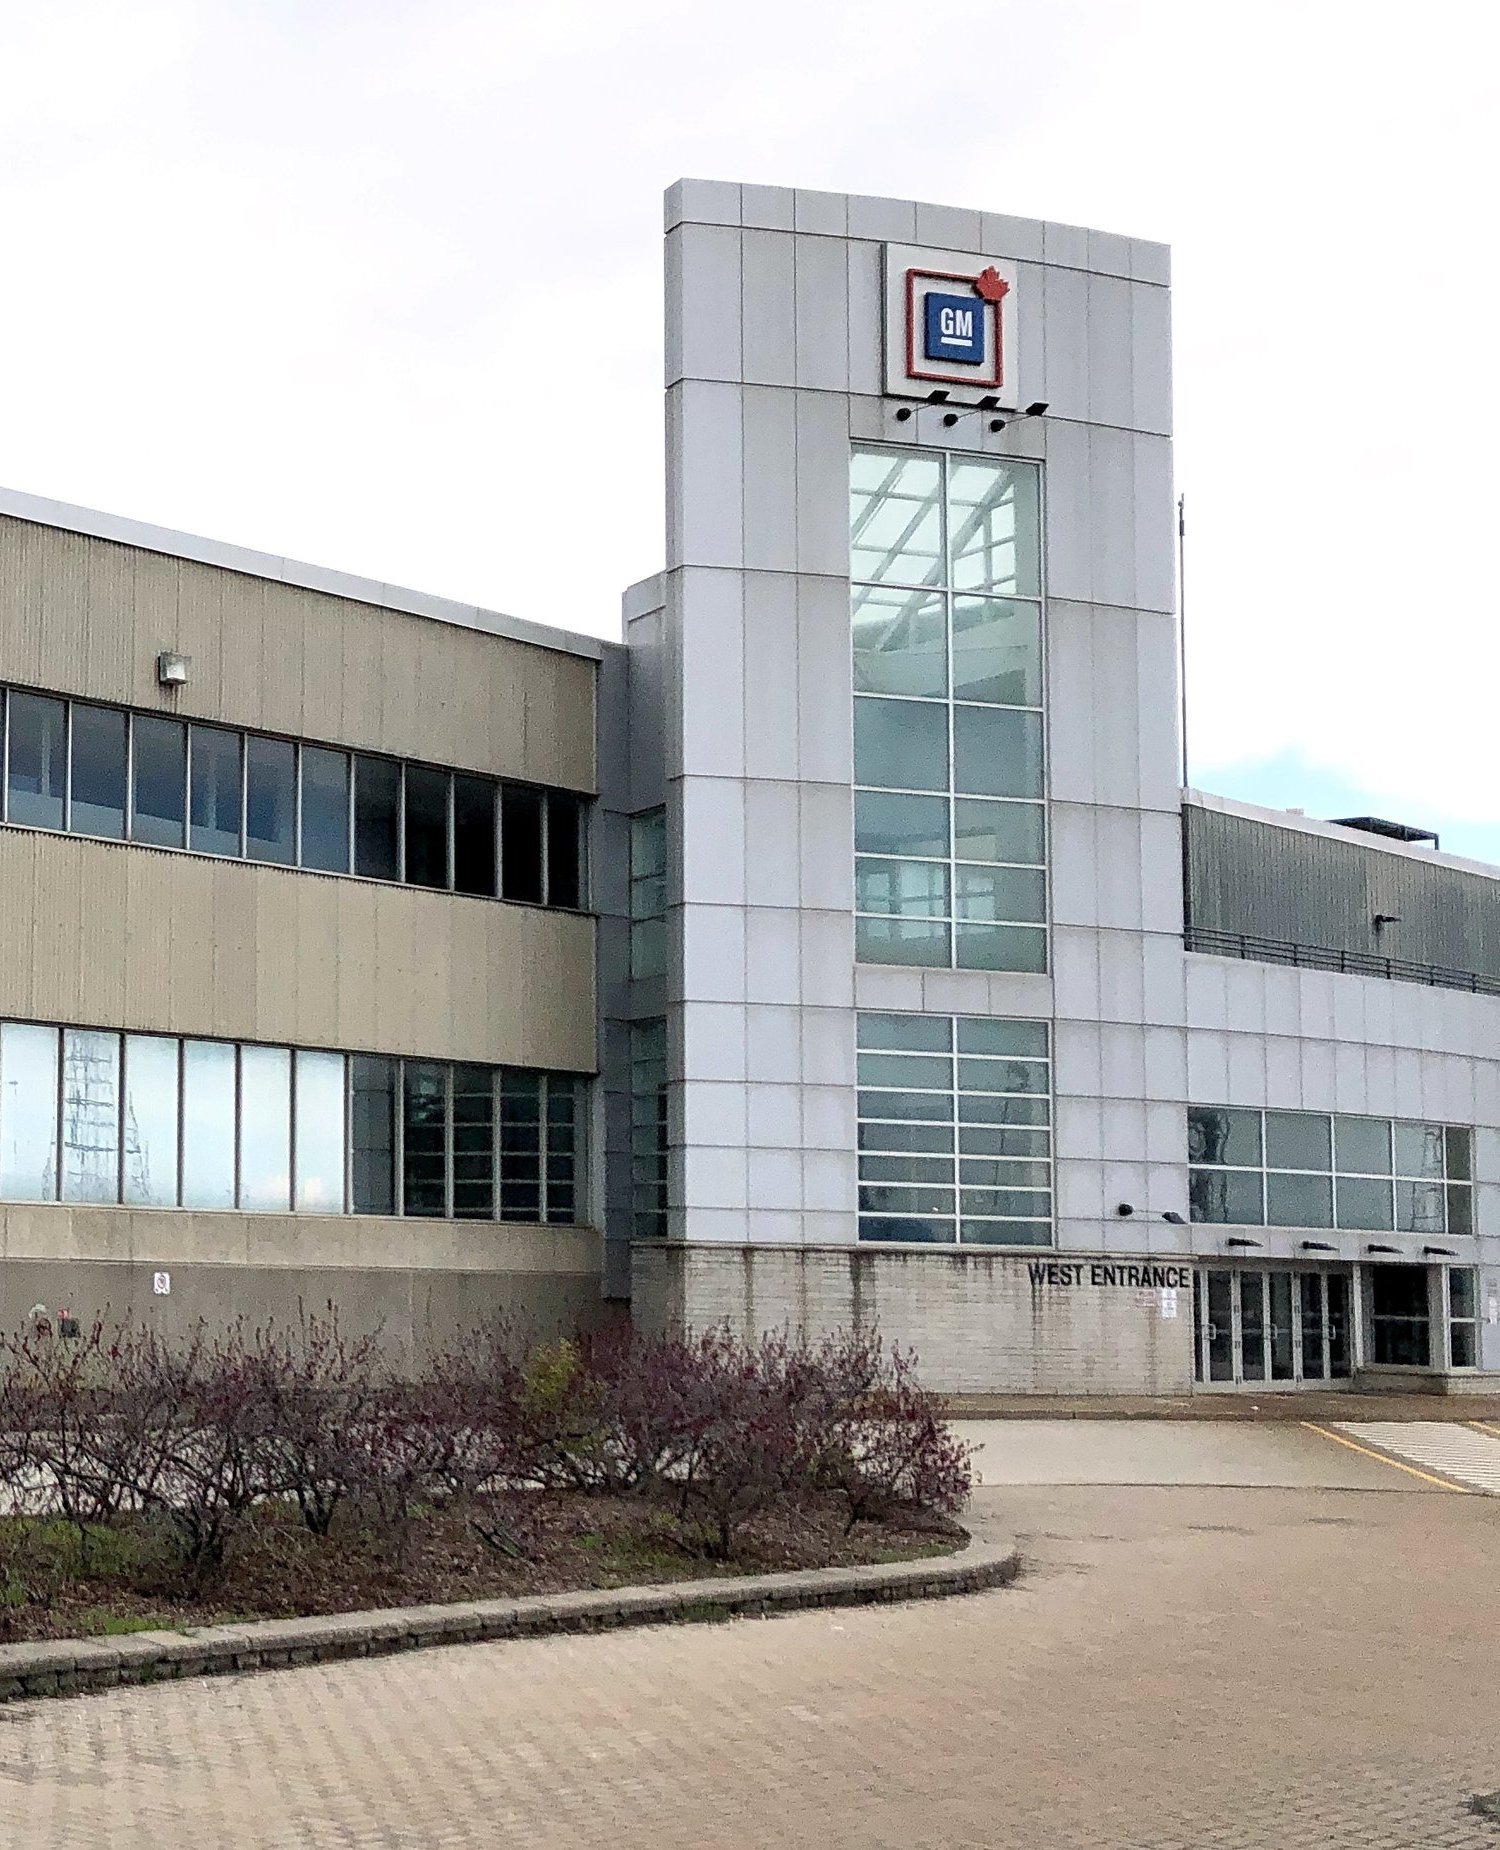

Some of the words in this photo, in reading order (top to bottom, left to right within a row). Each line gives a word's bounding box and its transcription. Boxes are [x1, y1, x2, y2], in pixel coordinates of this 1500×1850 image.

[940, 307, 973, 338] GM
[1028, 1263, 1083, 1286] WEST
[1091, 1264, 1190, 1288] ENTRANCE
